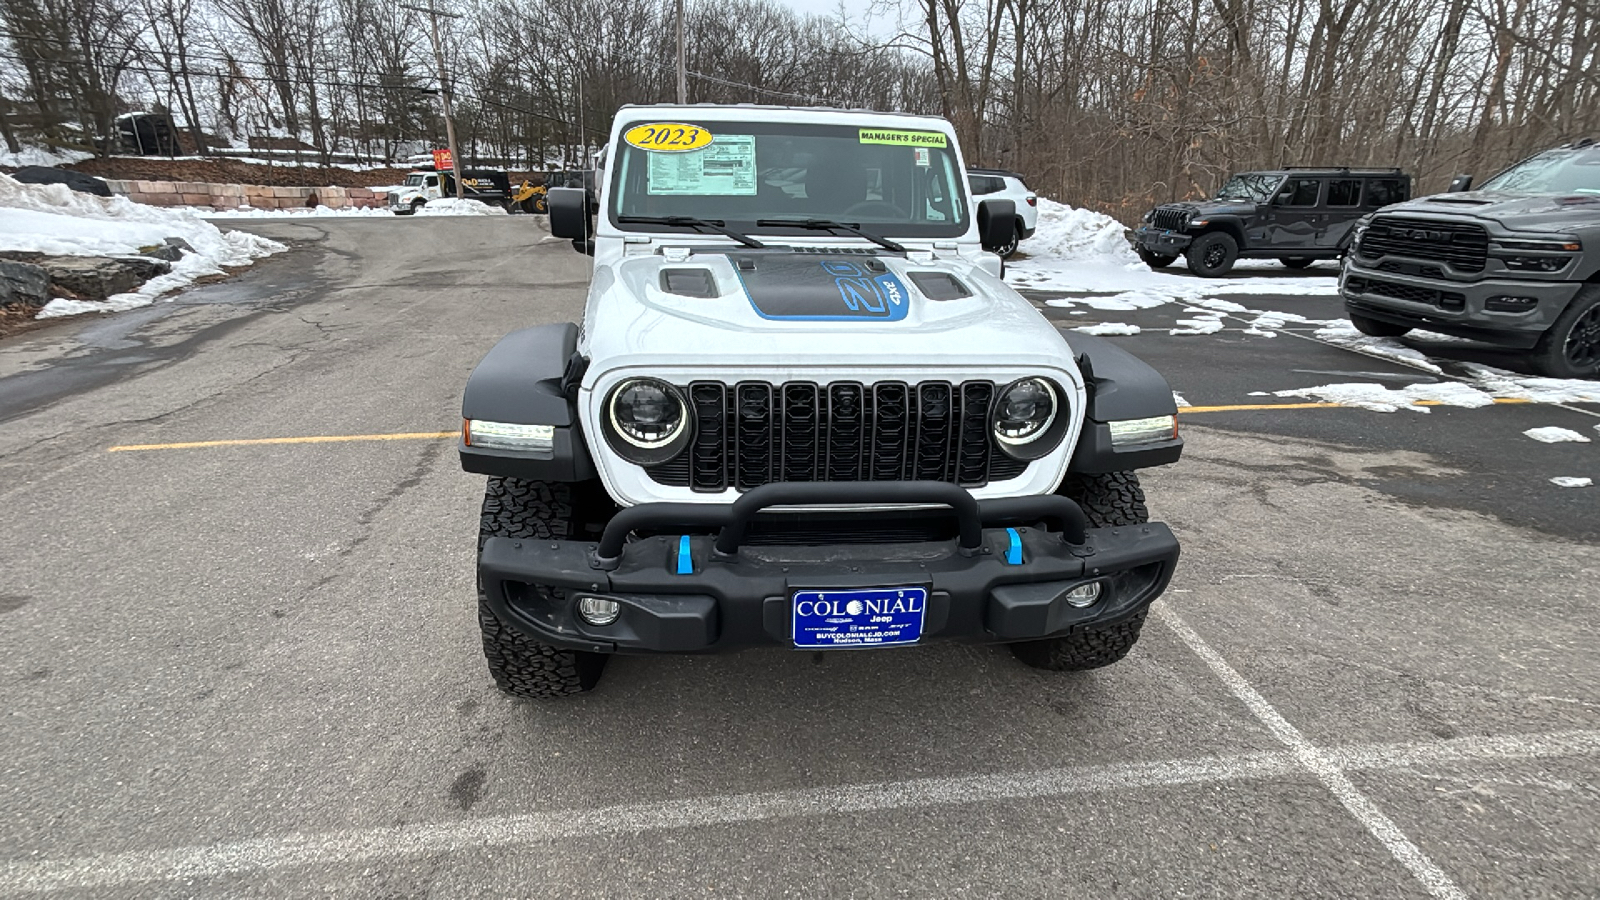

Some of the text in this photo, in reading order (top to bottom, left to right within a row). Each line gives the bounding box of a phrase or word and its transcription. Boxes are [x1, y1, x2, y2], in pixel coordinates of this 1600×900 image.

[638, 127, 699, 146] 2023
[861, 132, 945, 144] MANAGER'S SPECIAL
[883, 281, 901, 306] 4xe
[797, 597, 922, 617] COLONIAL
[870, 615, 893, 624] Jeep
[816, 630, 901, 639] BUYCOLONIALCJD.COM
